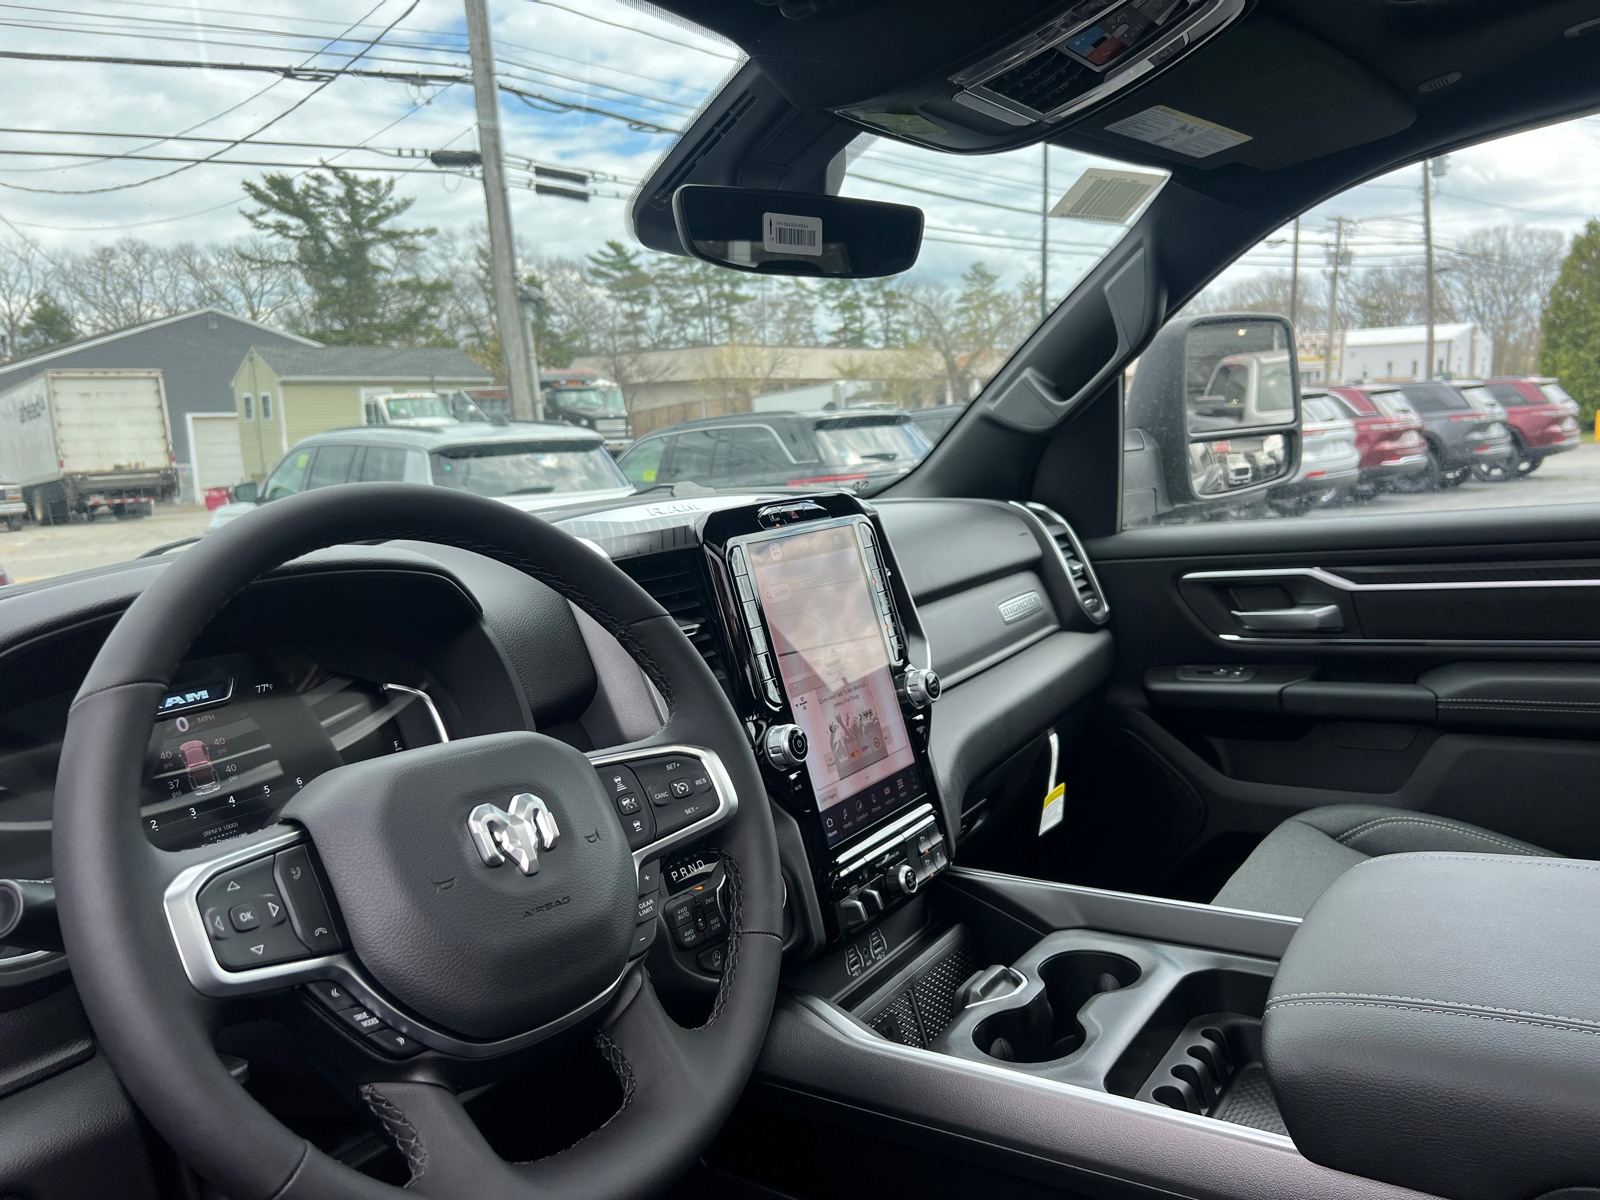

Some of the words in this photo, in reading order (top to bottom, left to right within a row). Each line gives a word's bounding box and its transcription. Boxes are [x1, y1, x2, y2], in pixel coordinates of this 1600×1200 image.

[646, 502, 702, 517] RAM
[159, 690, 210, 709] AM
[176, 717, 189, 732] 0
[197, 714, 215, 724] MPH
[214, 737, 226, 746] 40
[160, 751, 172, 760] 40
[163, 762, 174, 770] psi
[225, 764, 237, 773] 40
[228, 774, 239, 783] psi
[296, 777, 303, 786] 6
[694, 777, 707, 787] RES
[168, 779, 180, 790] 37
[263, 785, 270, 794] 5
[172, 790, 182, 799] psi
[654, 791, 670, 800] CANC
[228, 795, 236, 804] 4
[189, 807, 197, 816] 3
[150, 820, 158, 829] 2
[522, 896, 572, 920] AIRBAG
[638, 898, 654, 910] GEAR
[638, 905, 654, 917] LIMIT
[239, 911, 254, 922] OK
[353, 1011, 370, 1021] DRIVE
[360, 1017, 380, 1028] MODES
